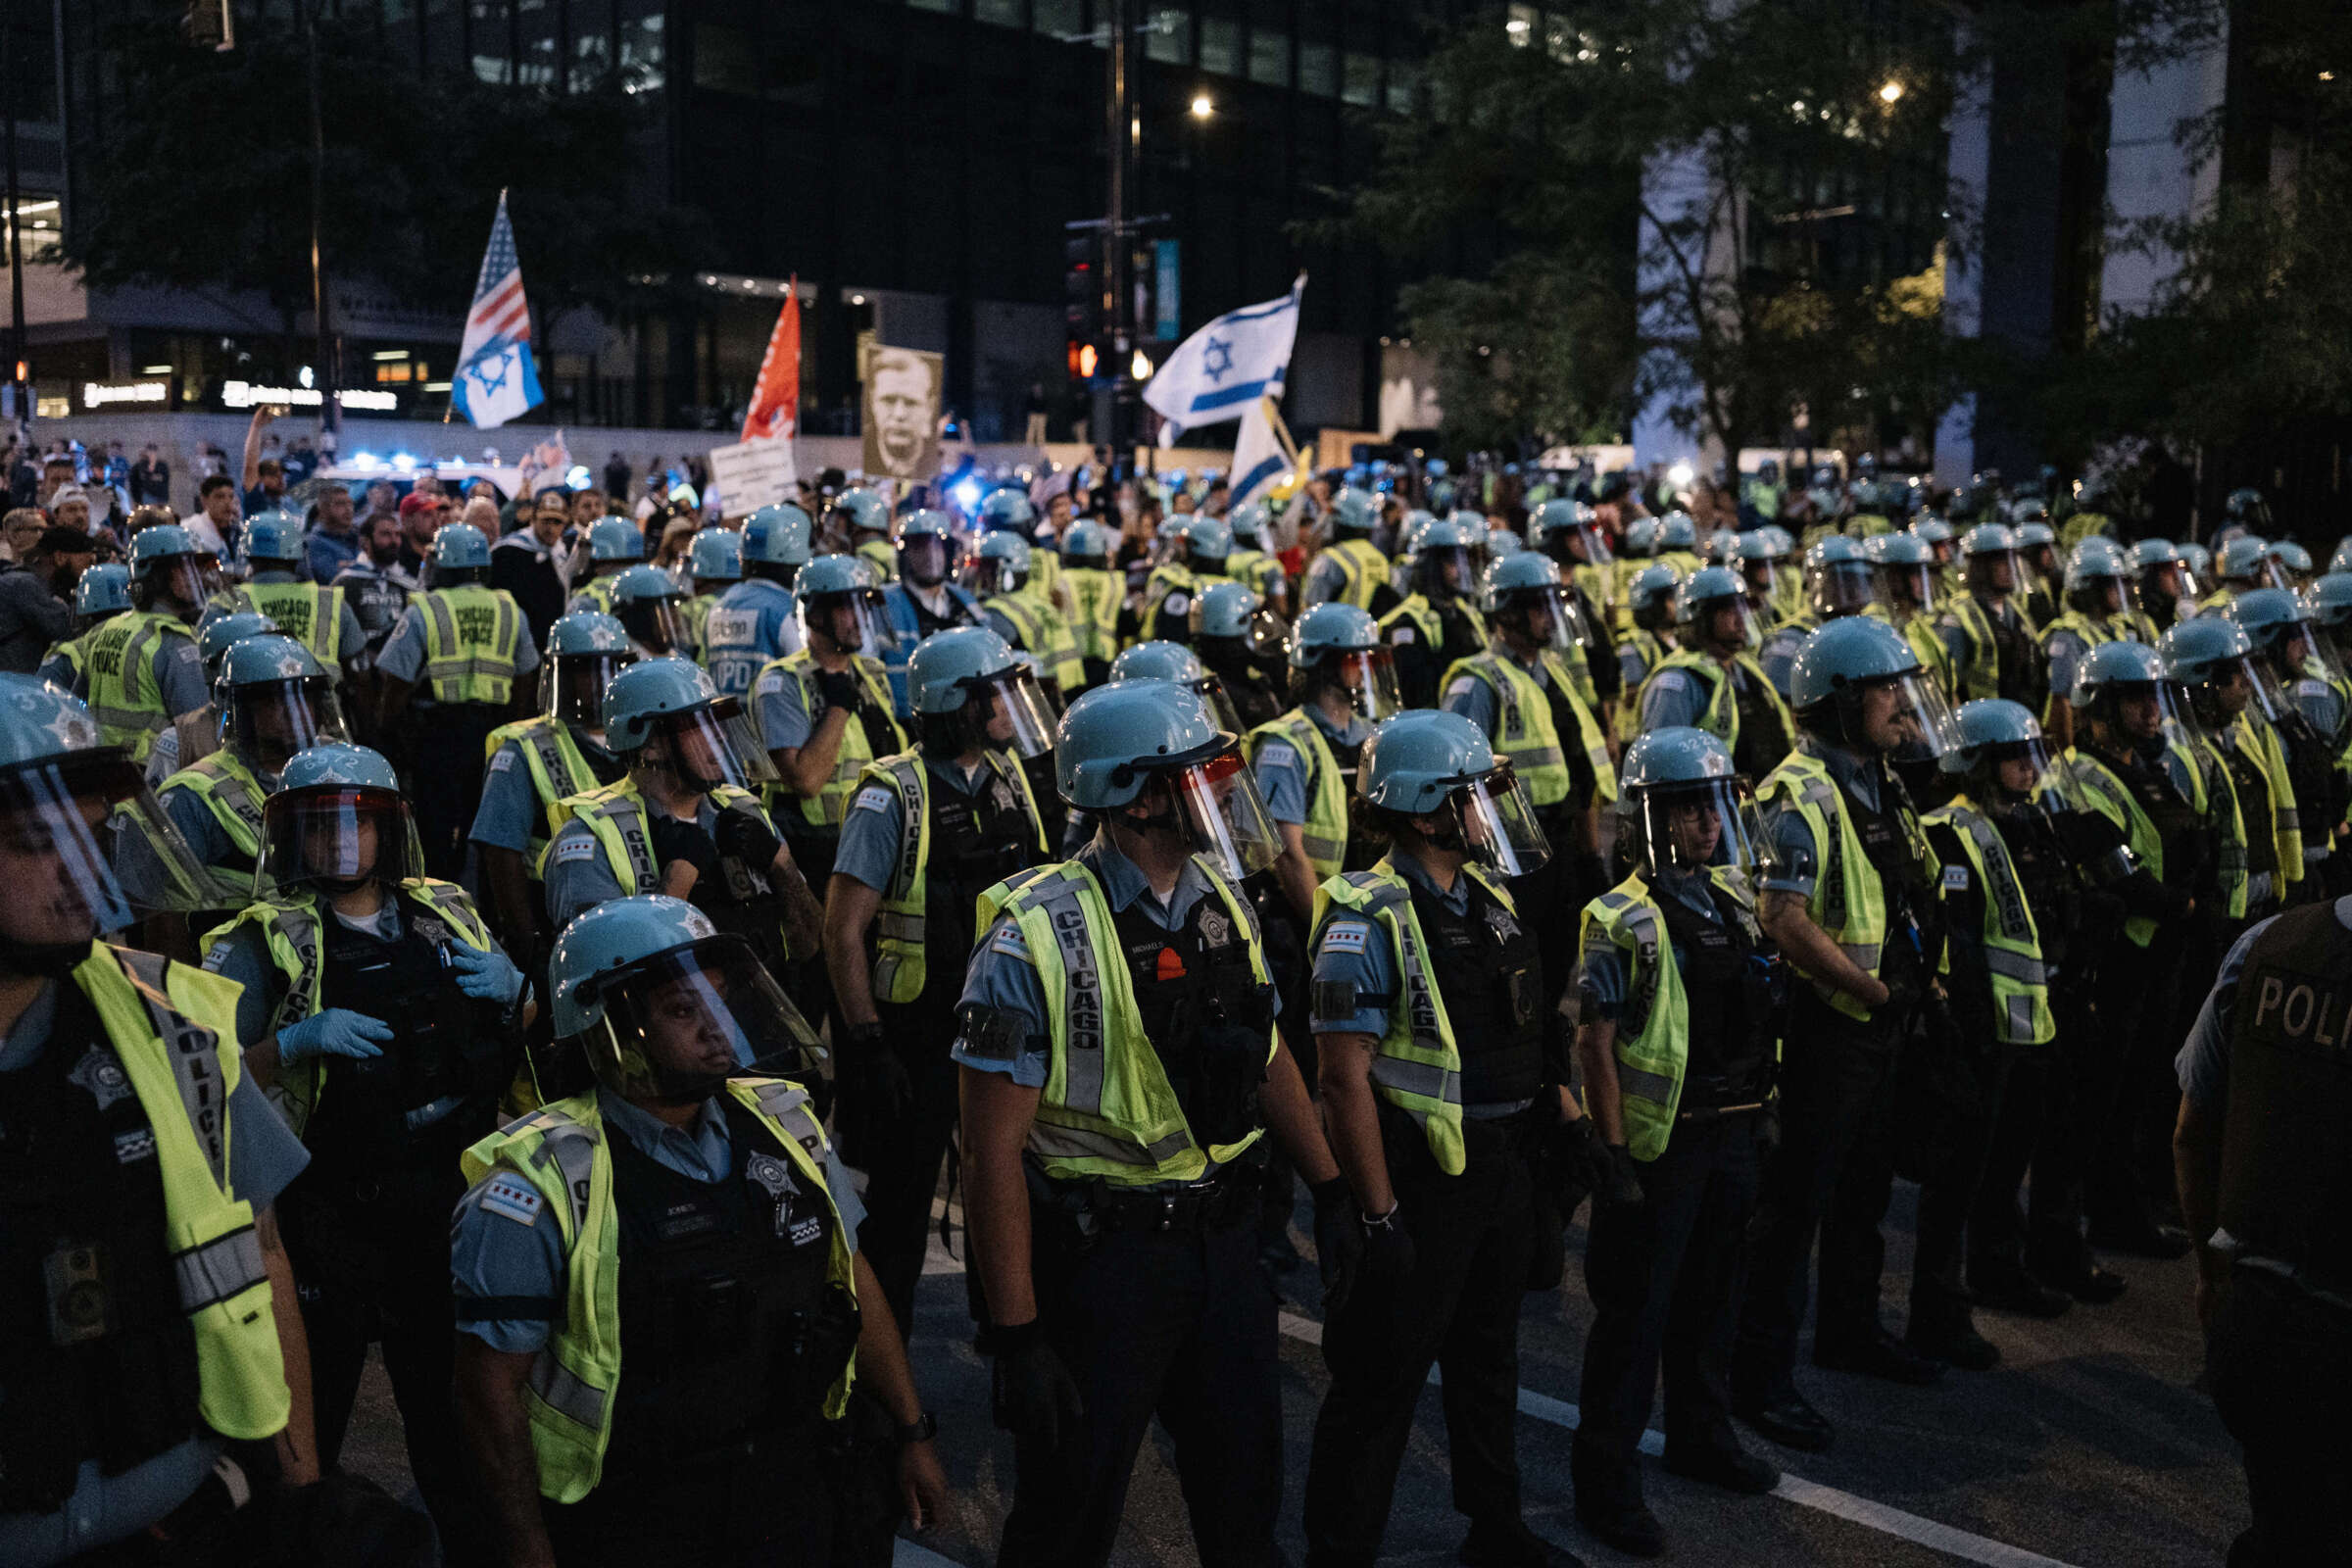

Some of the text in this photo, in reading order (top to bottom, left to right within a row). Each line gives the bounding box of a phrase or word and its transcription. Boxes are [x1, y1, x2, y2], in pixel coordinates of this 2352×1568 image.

[261, 597, 313, 621] CHICAGO
[276, 617, 310, 642] OLICE
[91, 649, 122, 677] POLICE
[625, 830, 660, 895] CHIC
[1054, 909, 1100, 1051] CHICAGO
